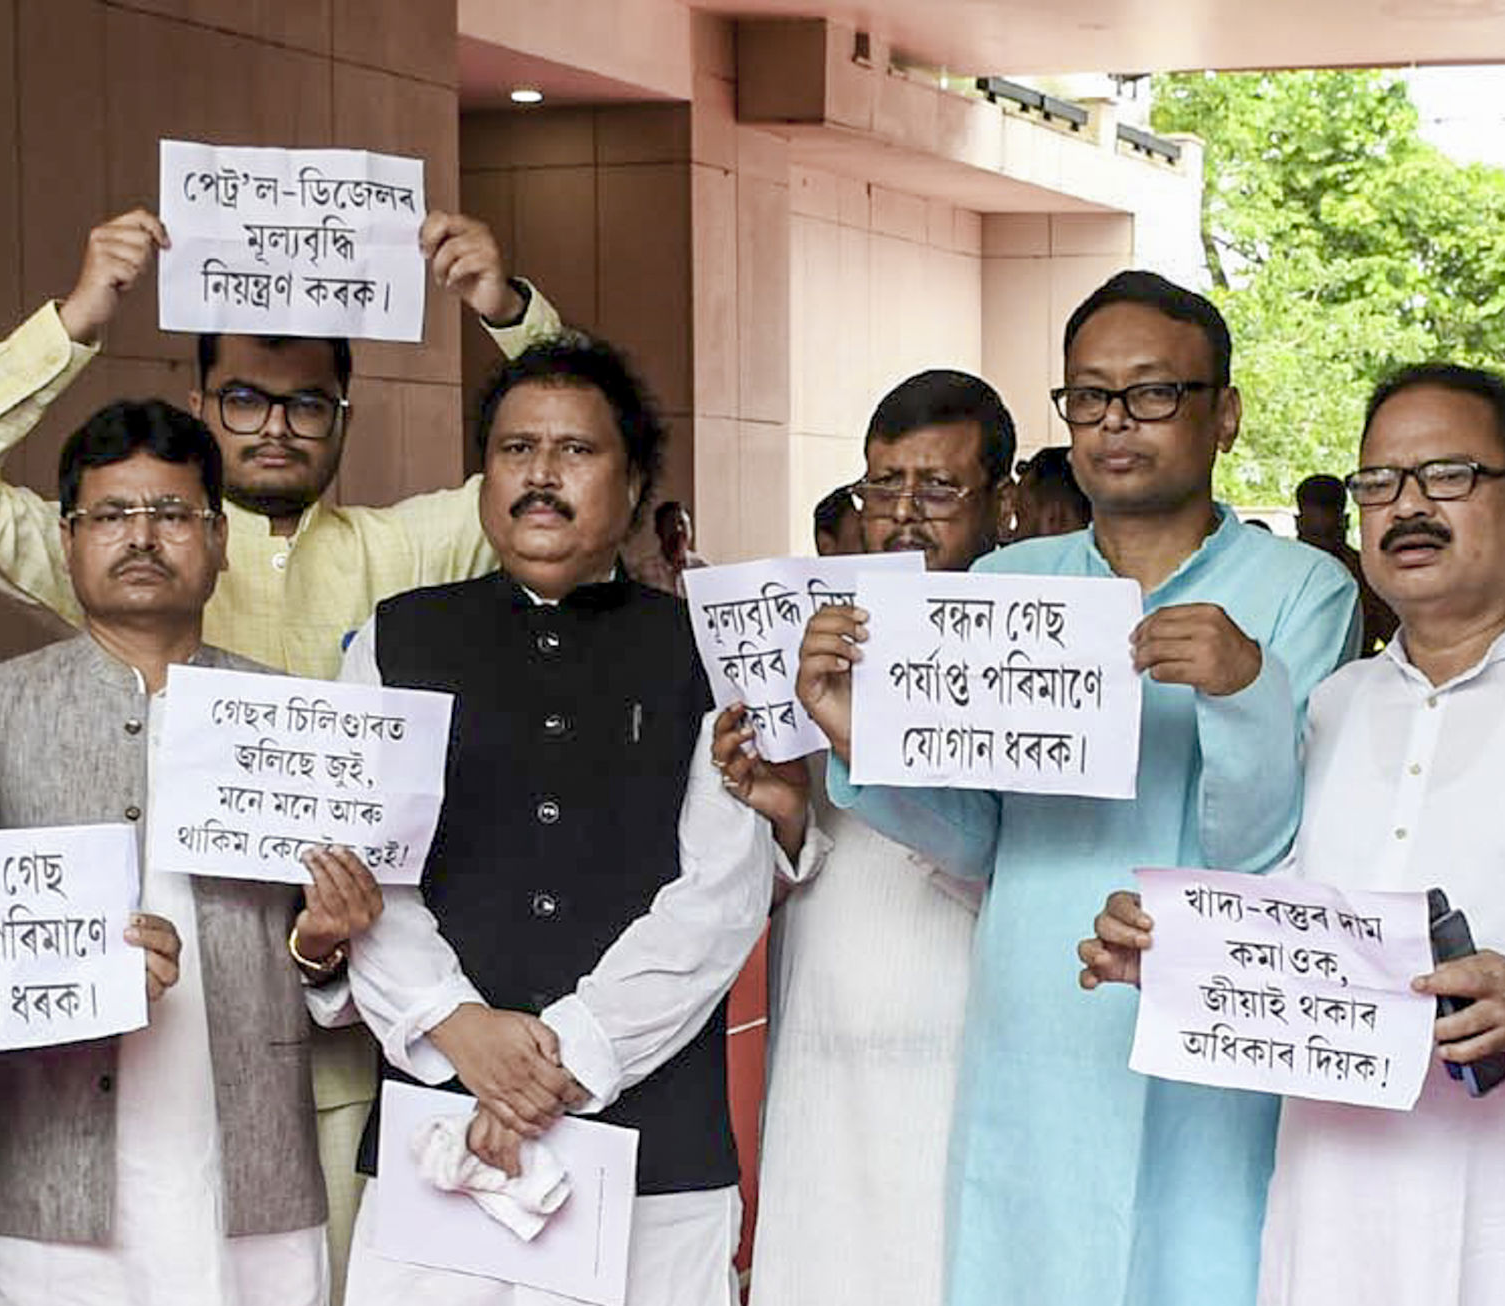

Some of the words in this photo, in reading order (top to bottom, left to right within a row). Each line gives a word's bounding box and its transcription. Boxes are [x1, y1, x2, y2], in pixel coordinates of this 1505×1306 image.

[243, 215, 356, 267] মূল্যবৃদ্ধি
[702, 582, 801, 645] মূল্যবৃদ্ধি
[926, 598, 995, 641] ৰন্ধন
[1006, 599, 1066, 648] গেছ
[718, 640, 787, 691] কৰিব
[889, 647, 969, 707] পৰ্যাপ্ত
[981, 649, 1103, 709] পৰিমাণে
[212, 700, 278, 731] গেছৰ
[286, 697, 406, 740] চিলিণ্ডাৰত
[234, 738, 317, 778] জ্বলিছে
[325, 750, 373, 789] জুই,
[903, 726, 994, 768] যোগান
[218, 786, 264, 813] মনে
[271, 792, 318, 820] মনে
[327, 799, 383, 825] আৰু
[178, 818, 249, 854] থাকিম
[4, 852, 66, 898] গেছ
[1185, 888, 1329, 931] খাদ্য-বস্তুৰ
[1335, 909, 1382, 944] দাম
[1225, 940, 1348, 988] কমাওক,
[1199, 975, 1288, 1025] জীয়াই
[1299, 995, 1378, 1030] থকাৰ
[1179, 1023, 1295, 1071] অধিকাৰ
